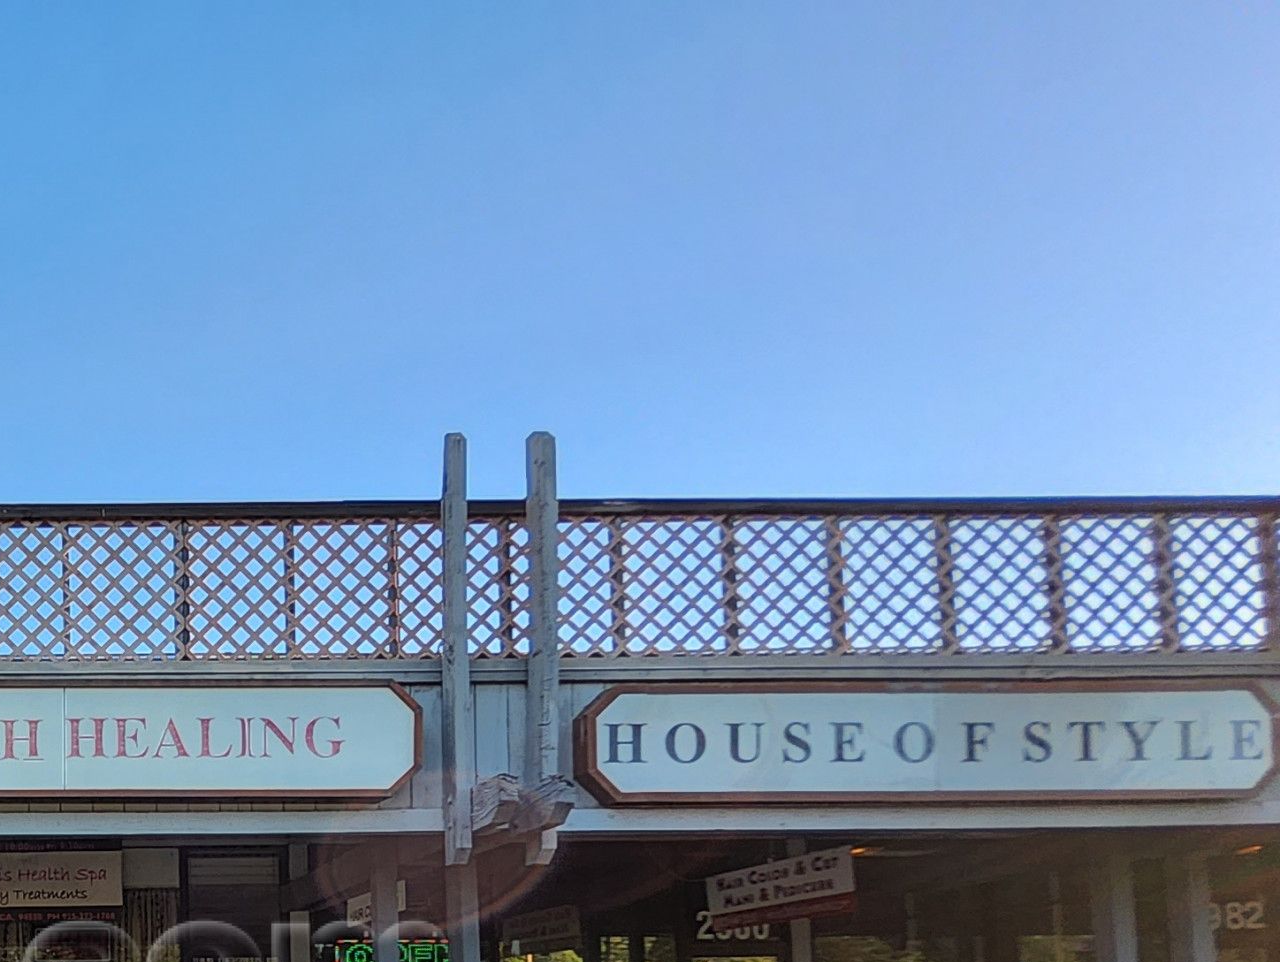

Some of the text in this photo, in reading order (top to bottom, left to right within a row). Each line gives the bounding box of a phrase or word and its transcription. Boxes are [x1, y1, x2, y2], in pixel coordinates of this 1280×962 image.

[65, 715, 346, 759] HEALING
[602, 718, 1265, 764] HOUSE OF STYLE
[17, 866, 70, 882] Health
[74, 867, 108, 887] Spa
[12, 888, 89, 901] Treatments
